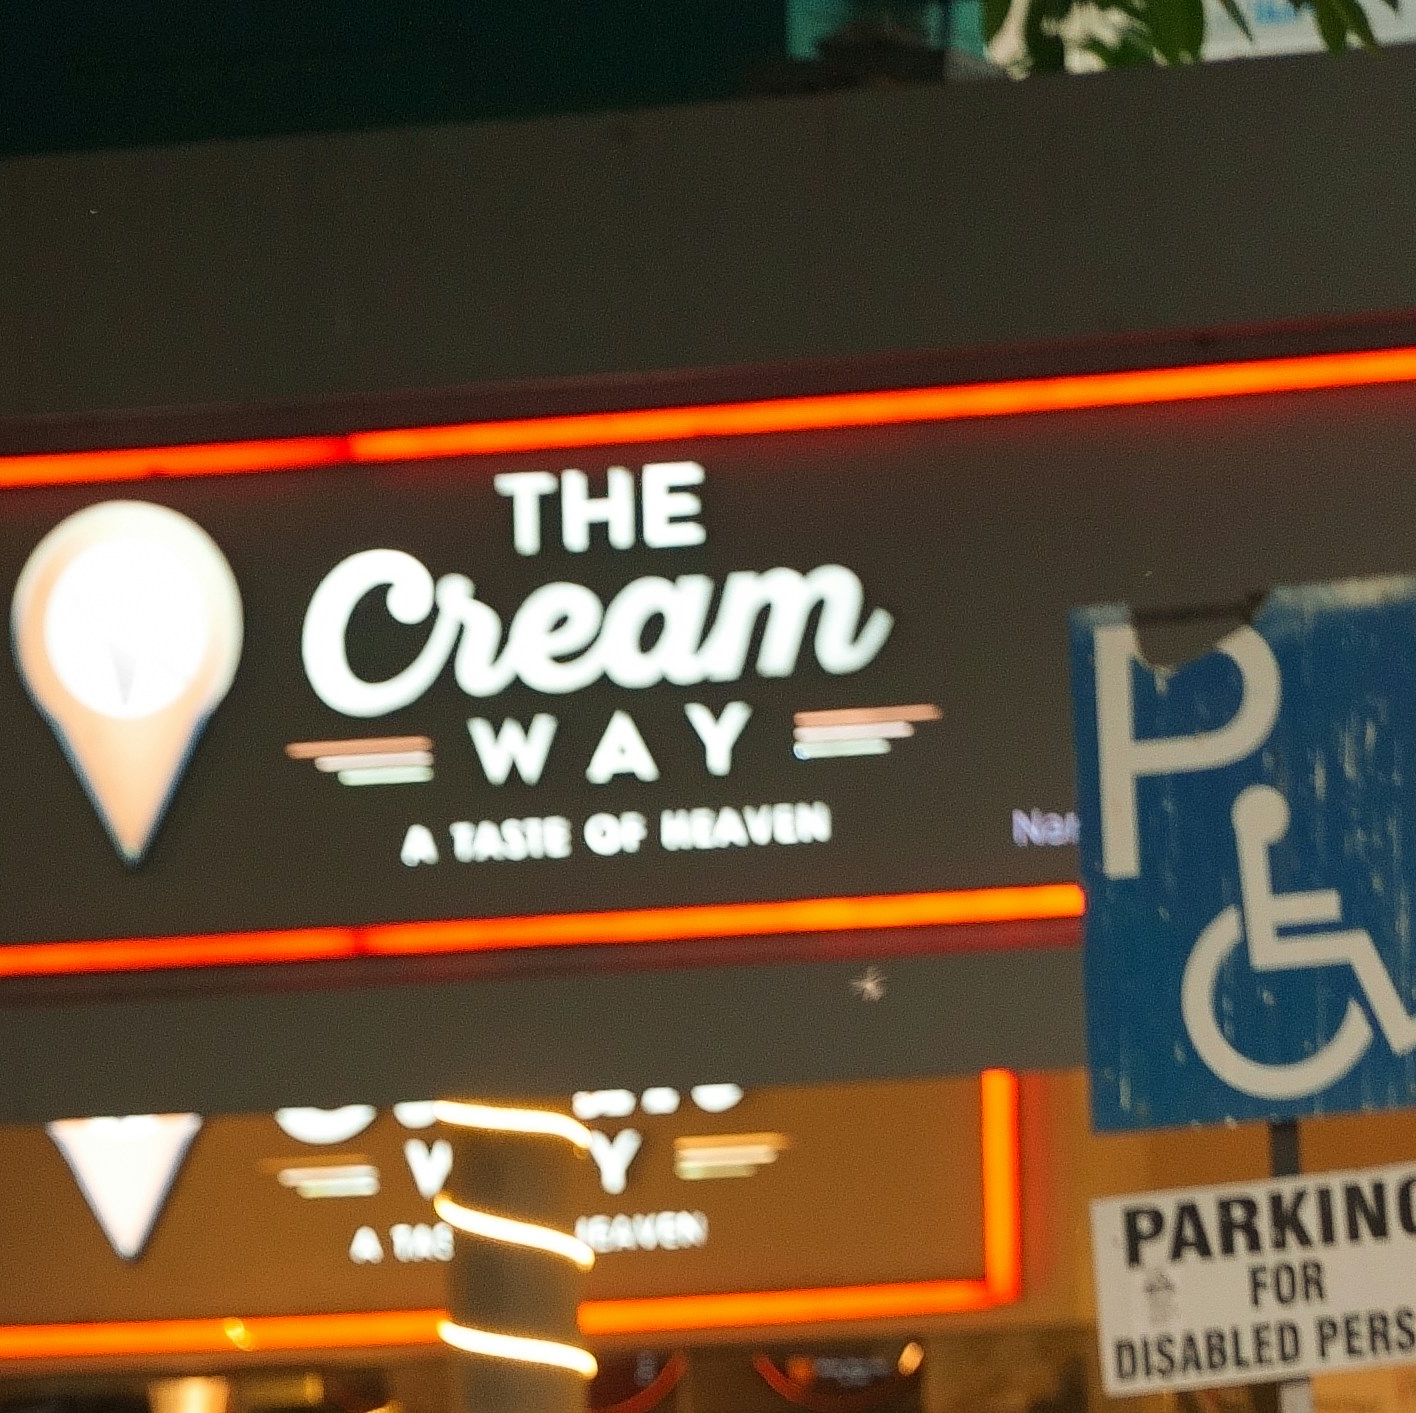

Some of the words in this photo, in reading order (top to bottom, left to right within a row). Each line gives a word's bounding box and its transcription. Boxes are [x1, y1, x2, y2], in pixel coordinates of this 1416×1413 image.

[493, 461, 706, 556] THE
[301, 548, 895, 718] Cream
[467, 700, 753, 786] WAY
[1094, 624, 1281, 881] P
[401, 824, 439, 867] A
[450, 815, 573, 864] TASTE
[584, 811, 646, 857] OF
[660, 801, 833, 852] HEAVEN
[349, 1225, 383, 1265] A
[390, 1221, 455, 1263] TAS
[1249, 1258, 1328, 1308] FOR
[1113, 1319, 1301, 1381] DISABLED
